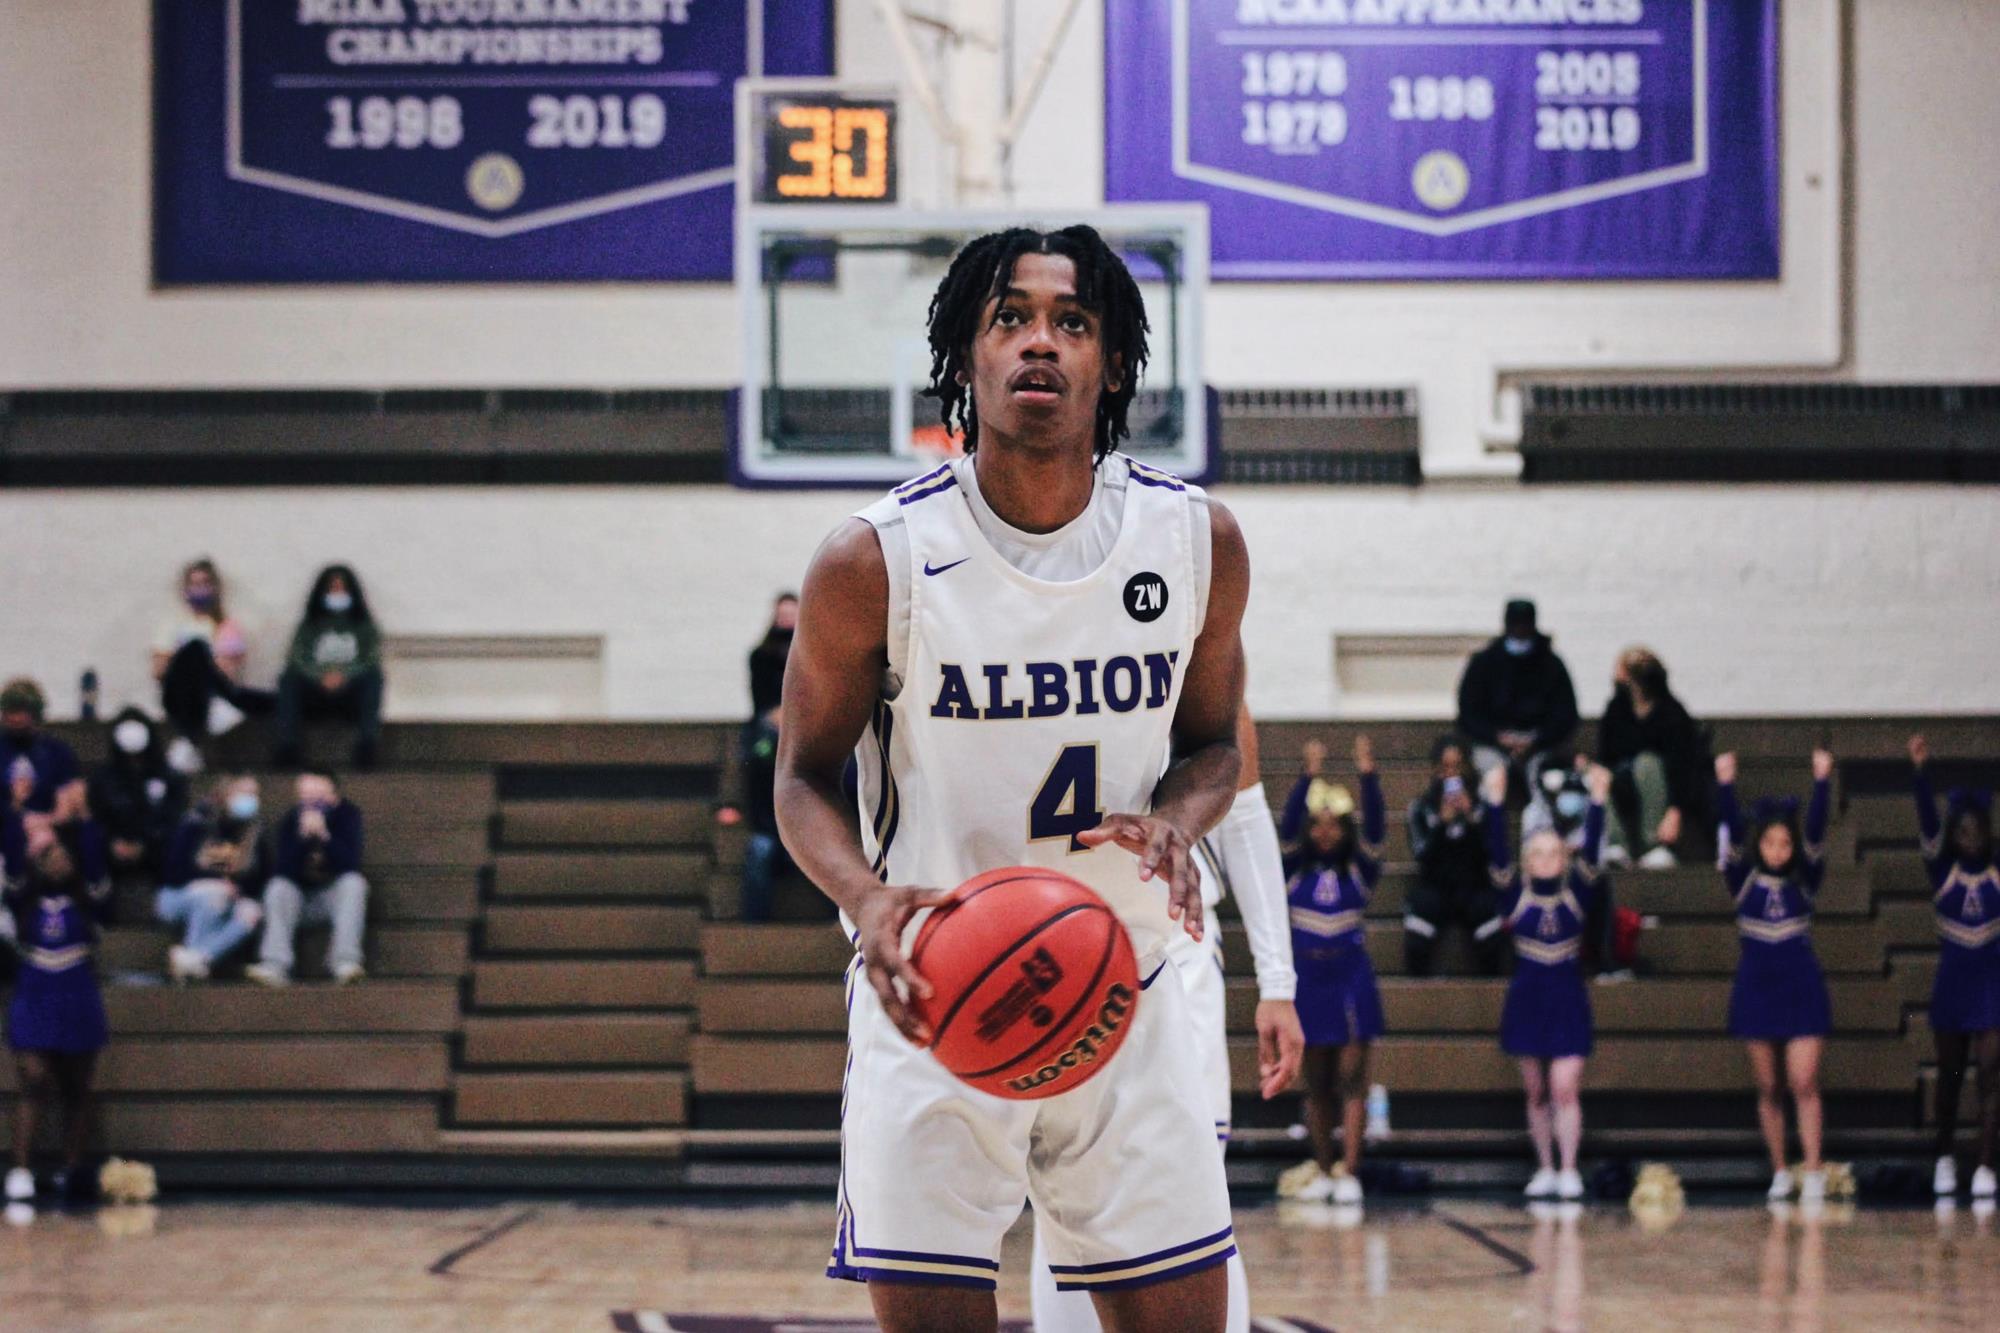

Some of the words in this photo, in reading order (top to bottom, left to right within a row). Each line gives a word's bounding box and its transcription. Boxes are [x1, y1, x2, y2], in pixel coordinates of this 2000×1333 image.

[327, 28, 664, 64] CHAMPIONSHIPS
[1241, 51, 1348, 95] 1978
[1535, 51, 1641, 96] 2005
[1388, 76, 1495, 121] 1998
[326, 96, 463, 149] 1998
[526, 94, 667, 149] 2019
[1241, 101, 1348, 145] 1979
[1534, 106, 1641, 150] 2019
[777, 106, 888, 198] 30
[1133, 582, 1161, 611] ZW
[929, 650, 1180, 721] ALBION
[1026, 740, 1107, 856] 4
